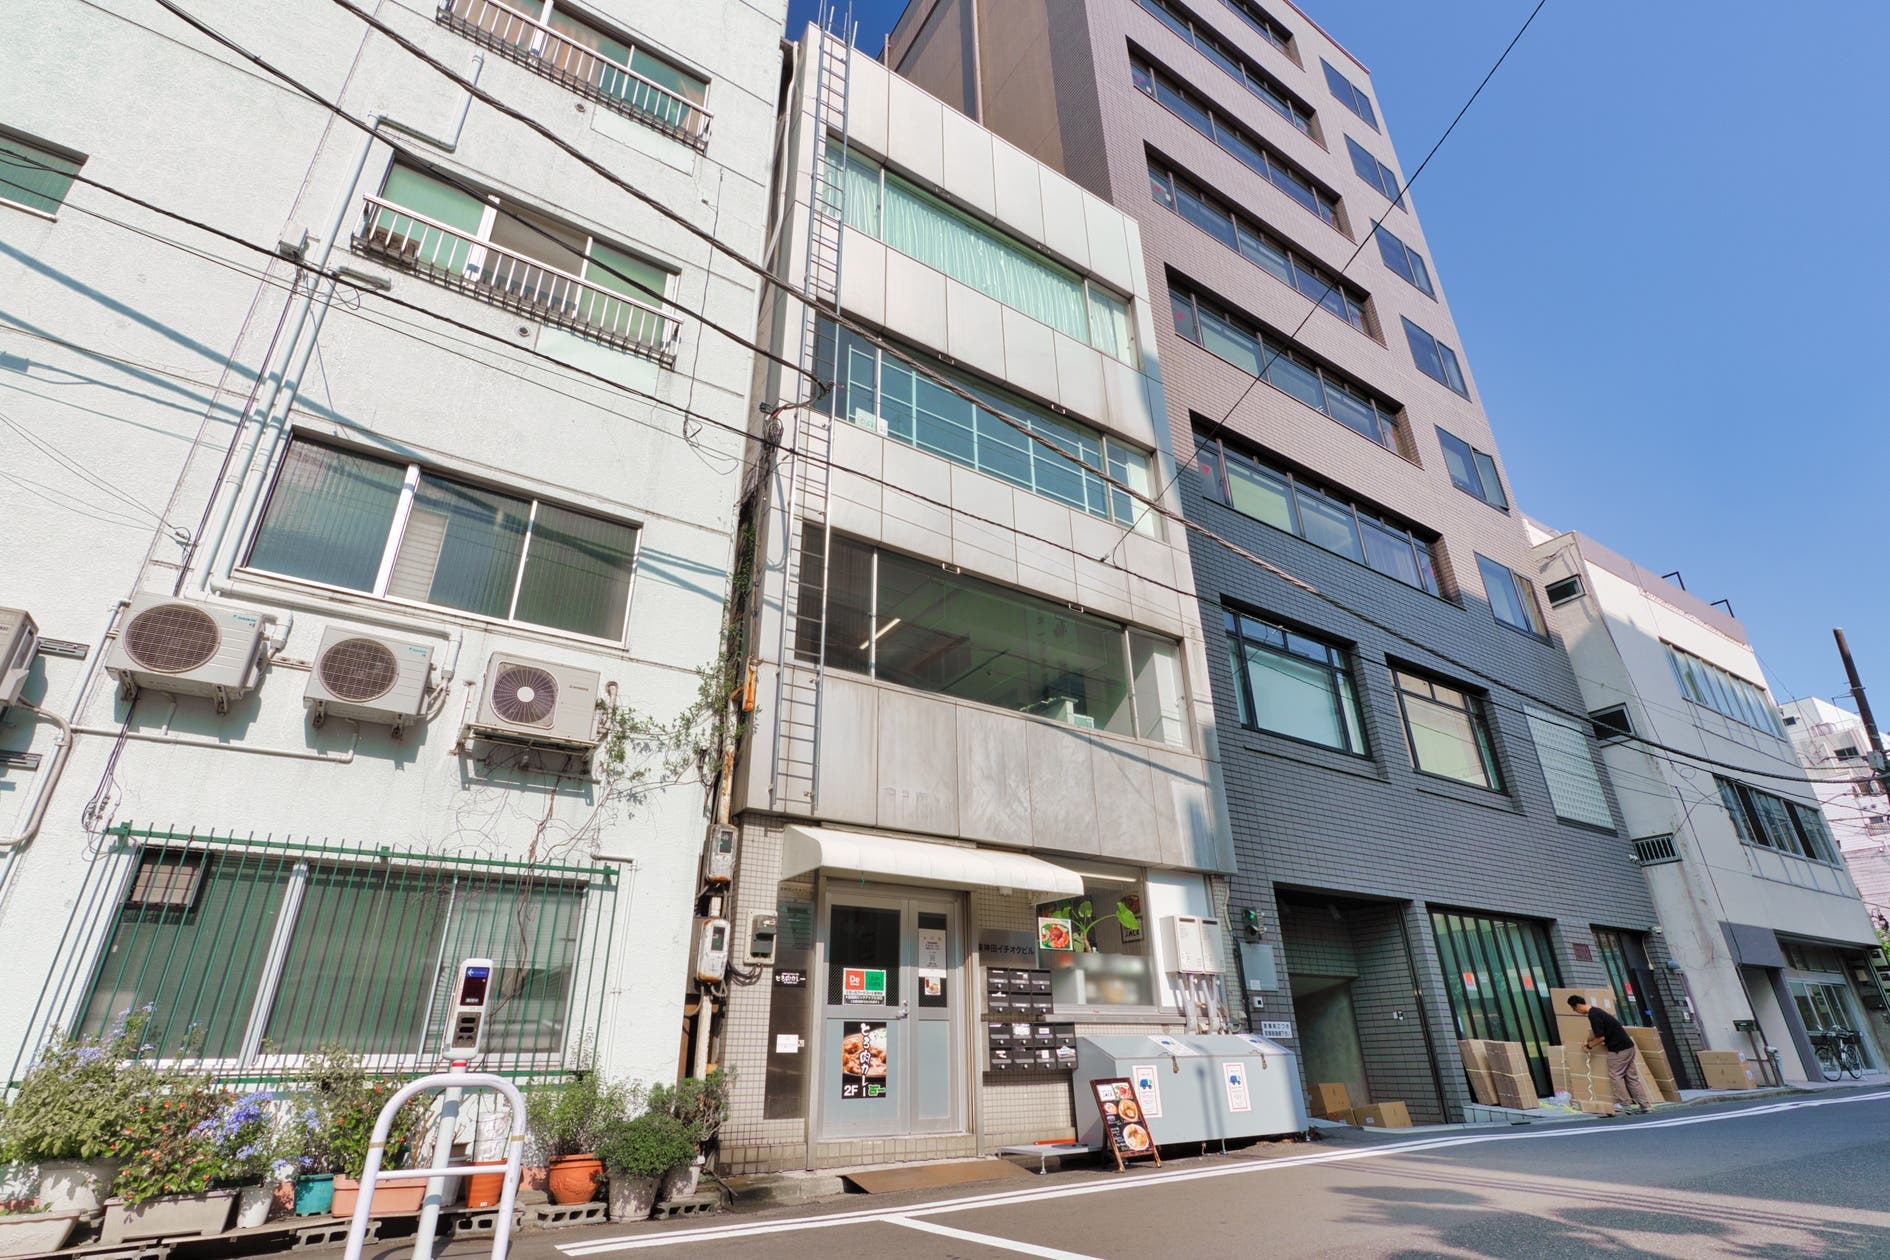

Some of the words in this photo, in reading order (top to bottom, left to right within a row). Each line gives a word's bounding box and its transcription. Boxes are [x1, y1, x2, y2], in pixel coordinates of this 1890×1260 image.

[859, 1022, 871, 1097] とろ肉カレー
[843, 1084, 859, 1096] 2F
